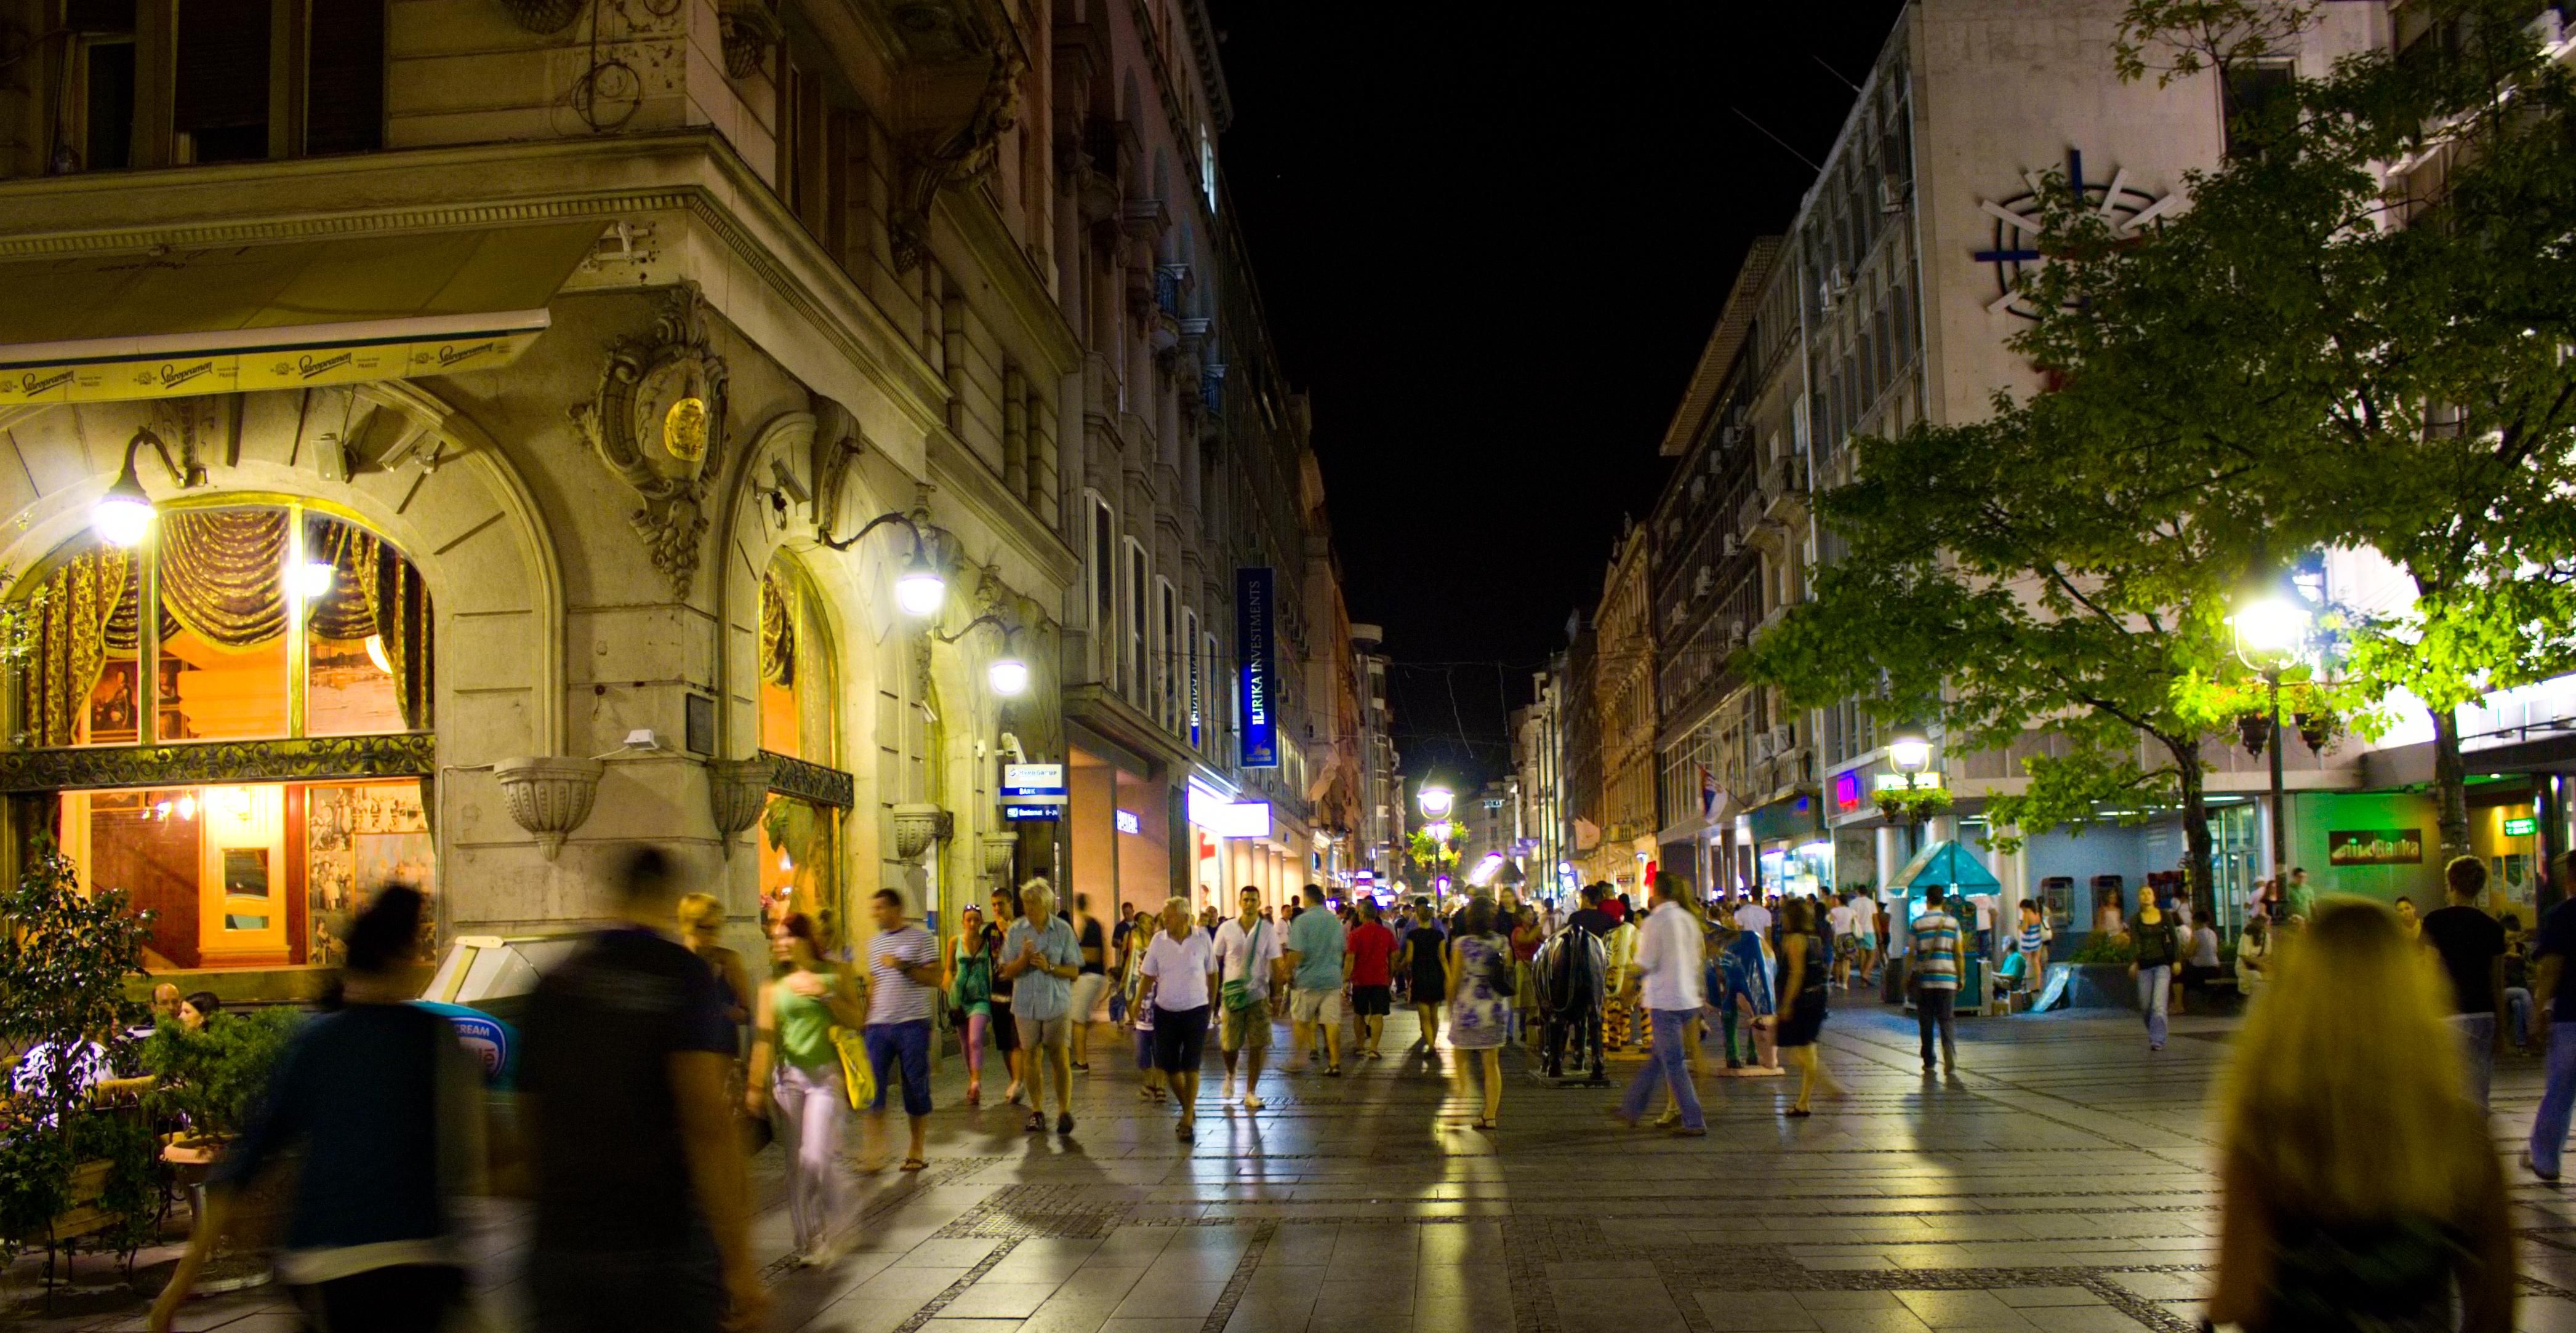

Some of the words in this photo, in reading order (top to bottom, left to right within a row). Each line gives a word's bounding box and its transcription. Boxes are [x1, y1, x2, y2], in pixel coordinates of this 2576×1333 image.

[299, 353, 351, 379] Staropramen
[438, 342, 493, 367] Staropramen
[22, 370, 74, 398] Staropramen
[161, 362, 212, 389] Staropramen
[1250, 580, 1262, 673] INVESTMENTS
[1251, 675, 1265, 725] ILIRIKA
